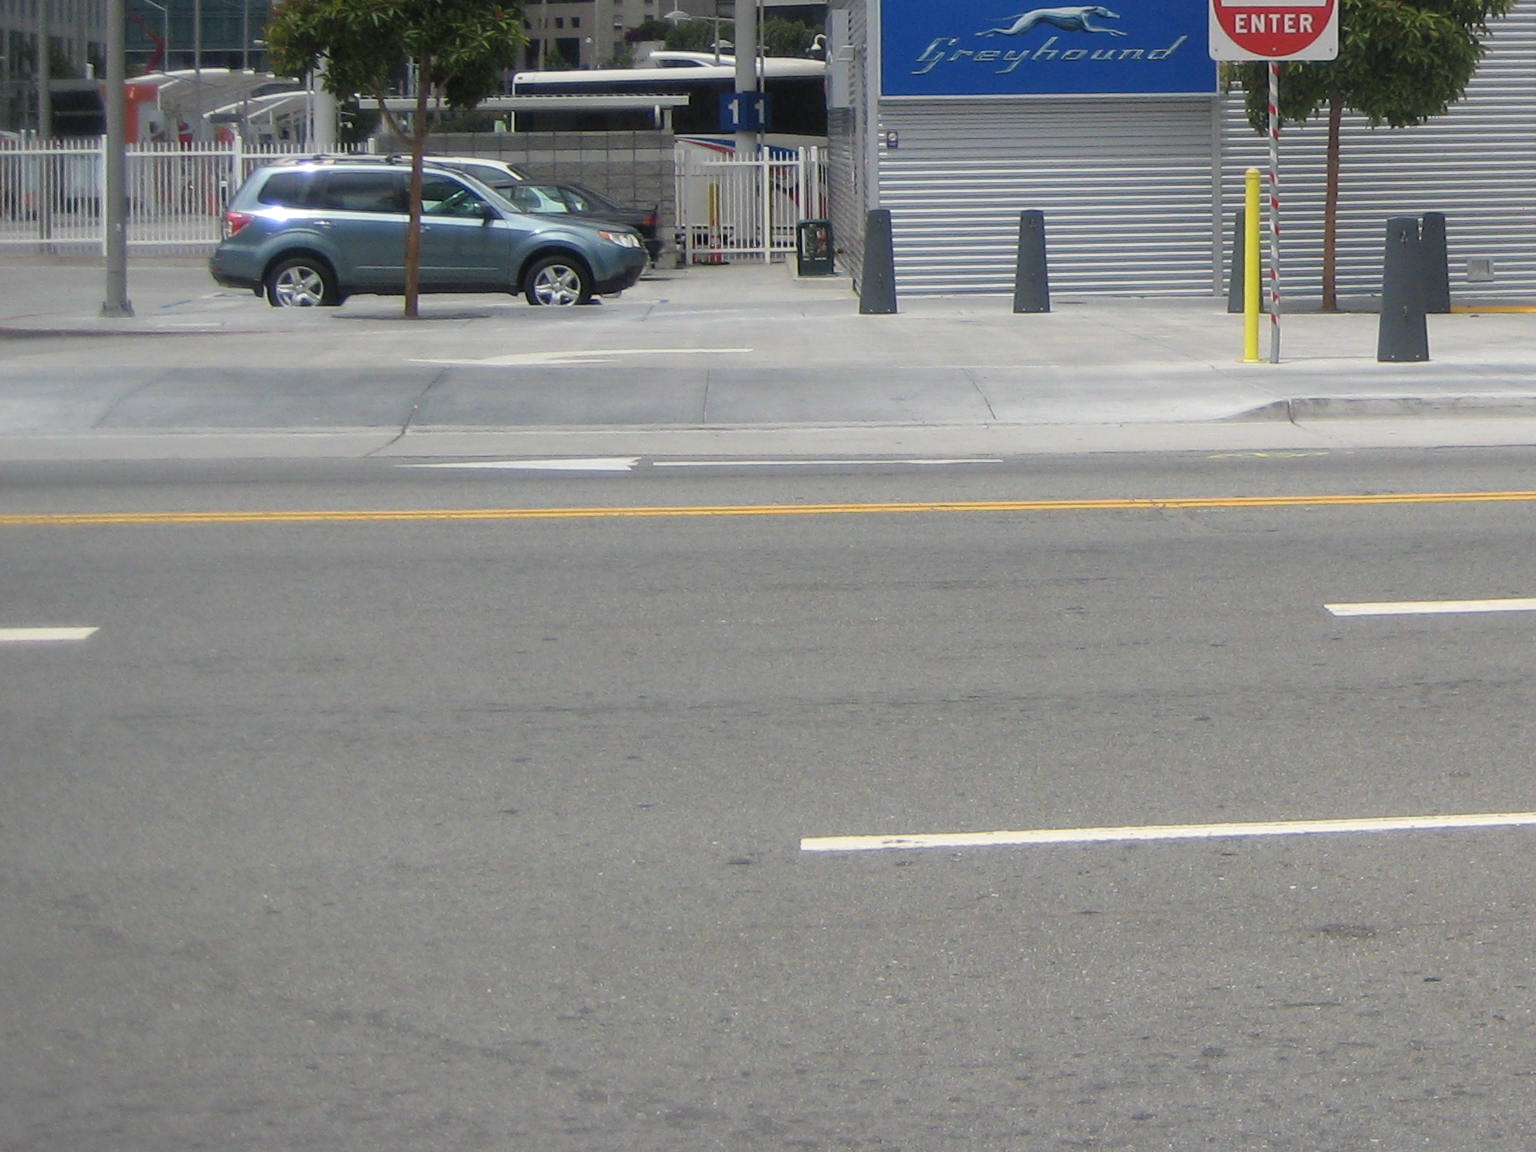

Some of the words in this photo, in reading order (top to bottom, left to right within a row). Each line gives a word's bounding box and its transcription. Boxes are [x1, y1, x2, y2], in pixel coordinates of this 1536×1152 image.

[1234, 13, 1314, 34] ENTER
[910, 35, 1189, 76] Greyhound
[727, 98, 739, 124] 1
[754, 98, 765, 124] 1
